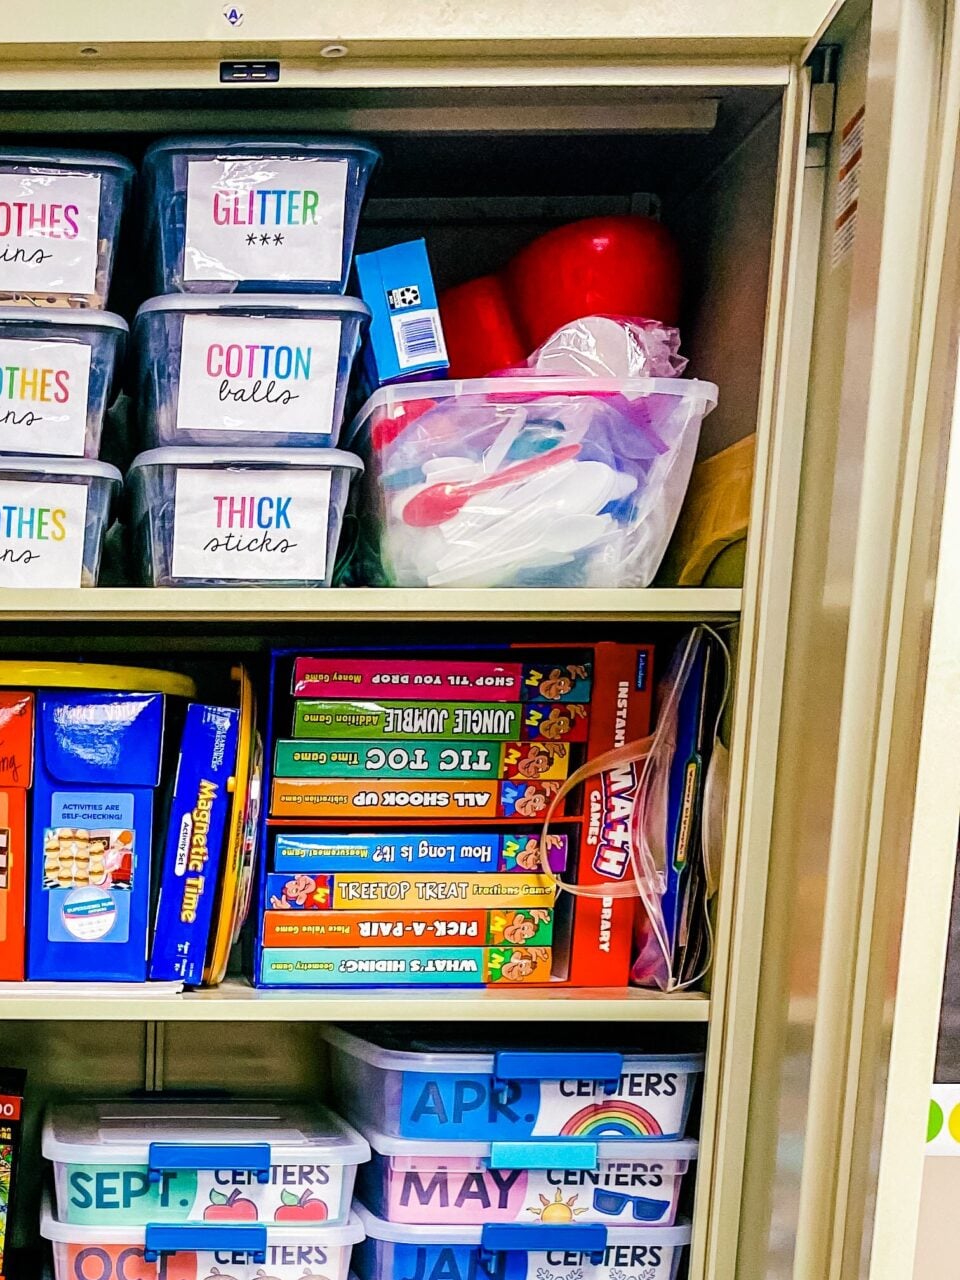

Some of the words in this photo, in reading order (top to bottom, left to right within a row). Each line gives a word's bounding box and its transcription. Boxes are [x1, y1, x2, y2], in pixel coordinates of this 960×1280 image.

[213, 189, 319, 226] GLITTER
[206, 343, 312, 380] COTTON
[217, 380, 299, 405] balls
[213, 496, 292, 529] THICK
[203, 533, 297, 554] sticks
[304, 672, 331, 683] Game
[332, 673, 362, 684] Money
[372, 674, 408, 684] DROP
[414, 675, 442, 685] YOU
[483, 675, 515, 687] SHOP
[303, 714, 332, 724] Game
[335, 714, 378, 725] Addition
[384, 708, 449, 734] JUMBLE
[453, 709, 515, 734] JUNGLE
[614, 681, 630, 748] INSTANT
[293, 751, 328, 764] Game
[331, 752, 359, 764] Time
[365, 748, 430, 770] TOC
[440, 749, 492, 770] TIC
[62, 803, 103, 811] ACTIVITIES
[105, 803, 120, 811] ARE
[353, 792, 380, 807] UP
[382, 792, 450, 807] SHOOK
[454, 792, 491, 807] ALL
[61, 812, 123, 821] SELF-CHECKING!
[586, 789, 601, 846] GAMES
[595, 763, 636, 877] MATH
[188, 779, 219, 873] Magnetic
[179, 821, 191, 850] Activity
[177, 851, 187, 866] Set
[372, 844, 395, 862] It?
[401, 845, 413, 862] Is
[418, 840, 455, 862] Long
[460, 845, 492, 862] How
[338, 882, 410, 900] TREETOP
[416, 882, 470, 899] TREAT
[472, 884, 519, 896] Fractions
[180, 876, 204, 924] Time
[274, 925, 300, 934] Game
[301, 925, 326, 934] Value
[327, 925, 350, 934] Place
[358, 921, 478, 937] PICK-A-PAIR
[338, 959, 403, 973] HIDING?
[410, 960, 478, 973] WHAT'S
[410, 1079, 535, 1125] APR.
[70, 1171, 189, 1209] SEPT.
[399, 1165, 524, 1208] MAY
